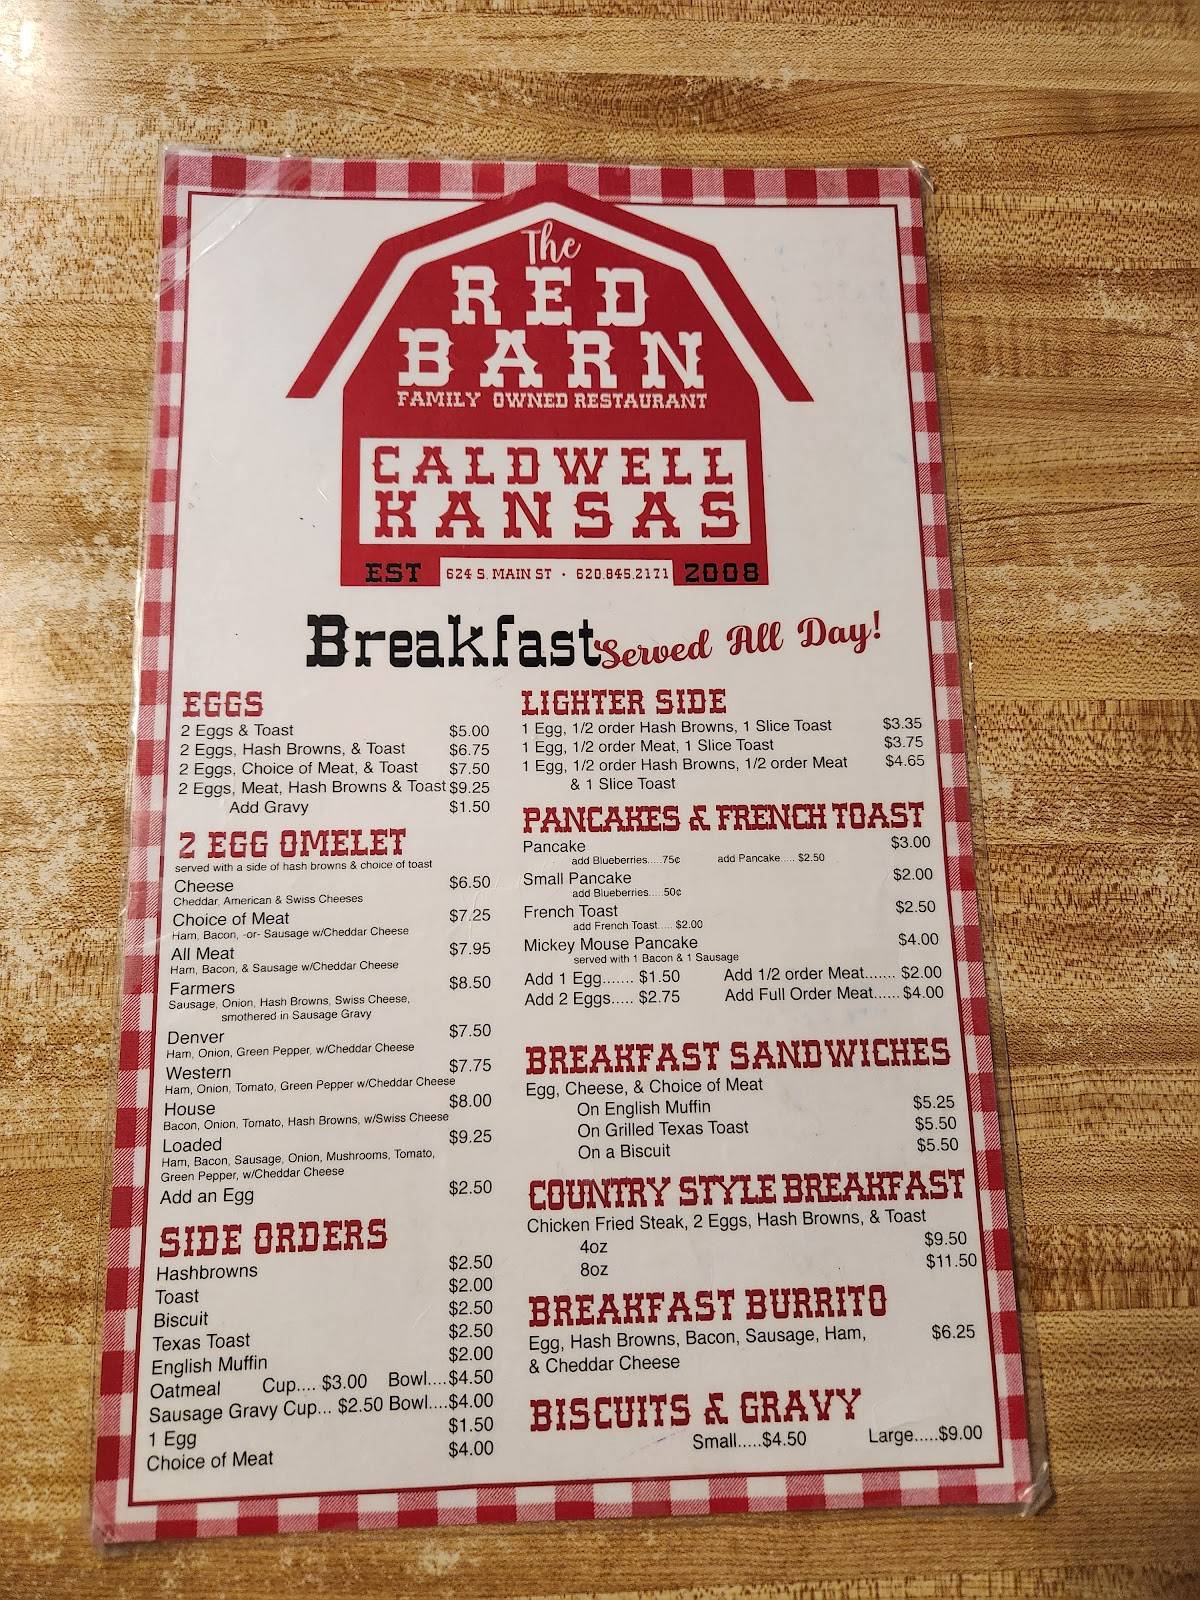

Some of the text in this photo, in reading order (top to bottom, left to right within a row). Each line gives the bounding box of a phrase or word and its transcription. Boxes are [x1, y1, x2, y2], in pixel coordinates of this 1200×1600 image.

[520, 220, 581, 265] The
[451, 265, 650, 327] RED
[397, 327, 705, 389] BARN
[397, 390, 707, 409] FAMILY OWNED RESTAURANT
[372, 445, 733, 486] CALDWELL
[375, 490, 740, 539] KANSAS
[365, 563, 421, 583] EST
[446, 568, 669, 580] 624 S. MAIN ST 620.845.2171
[685, 563, 759, 583] 2008
[306, 614, 601, 667] Breakfast
[594, 610, 882, 670] Served All Day!
[182, 691, 264, 718] EGGS
[521, 688, 727, 716] LIGHTER SIDE
[180, 723, 294, 740] 2 Eggs & Toast
[449, 724, 490, 738] $5.00
[883, 717, 922, 731] $3.35
[180, 742, 405, 760] 2 Eggs, Hash Browns, & Toast
[449, 743, 490, 757] $6.75
[522, 738, 774, 756] 1 Egg, 1/2 order Meat, 1 Slice Toast
[884, 735, 924, 750] $3.75
[885, 754, 925, 768] $4.65
[570, 777, 676, 791] & 1 Slice Toast
[229, 800, 309, 816] Add Gravy
[449, 800, 490, 814] $1.50
[523, 801, 925, 834] PANCAKES & FRENCH TOAST
[179, 828, 406, 859] 2 EGG OMELET
[523, 840, 586, 853] Pancake
[891, 835, 931, 850] $3.00
[175, 860, 432, 873] served with a side of hash browns & choice of toast
[893, 868, 933, 882] $2.00
[174, 879, 234, 893] Cheese
[449, 875, 491, 890] $6.50
[523, 871, 632, 886] Small Pancake
[172, 912, 290, 927] Choice of Meat
[449, 908, 491, 923] $7.25
[524, 904, 618, 919] French Toast
[524, 936, 698, 954] Mickey Mouse Pancake
[898, 932, 939, 946] $4.00
[170, 946, 235, 961] All Meat
[449, 942, 491, 957] $7.95
[170, 982, 235, 996] Farmers
[449, 975, 491, 991] $8.50
[221, 1008, 372, 1022] smothered in Sausage Gravy
[168, 1031, 225, 1045] Denver
[449, 1023, 492, 1039] $7.50
[525, 1037, 952, 1075] BREAKFAST SANDWICHES
[166, 1066, 231, 1080] Western
[449, 1058, 492, 1074] $7.75
[164, 1102, 216, 1116] House
[449, 1093, 492, 1110] $8.00
[577, 1099, 711, 1119] On English Muffin
[913, 1095, 955, 1111] $5.25
[163, 1136, 222, 1153] Loaded
[449, 1129, 492, 1146] $9.25
[917, 1137, 959, 1153] $5.50
[162, 1148, 435, 1168] Ham, Bacon, Sausage, Onion, Mushrooms, Tomato,
[578, 1143, 671, 1160] On a Biscuit
[528, 1168, 965, 1211] COUNTRY STYLE BREAKFAST
[159, 1218, 388, 1258] SIDE ORDERS
[924, 1231, 967, 1248] $9.50
[580, 1240, 608, 1254] 4oz
[448, 1254, 493, 1272] $2.50
[580, 1262, 608, 1277] 8oz
[926, 1252, 977, 1270] $11.50
[156, 1264, 258, 1281] Hashbrowns
[448, 1277, 493, 1295] $2.00
[155, 1289, 199, 1305] Toast
[448, 1300, 493, 1318] $2.50
[528, 1284, 888, 1328] BREAKFAST BURRITO
[154, 1310, 208, 1328] Biscuit
[932, 1324, 976, 1341] $6.25
[152, 1332, 250, 1352] Texas Toast
[152, 1354, 267, 1378] English Muffin
[150, 1380, 220, 1400] Oatmeal
[530, 1388, 862, 1432] BISCUITS & GRAVY
[448, 1440, 494, 1459] $4.00
[147, 1450, 274, 1472] Choice of Meat
